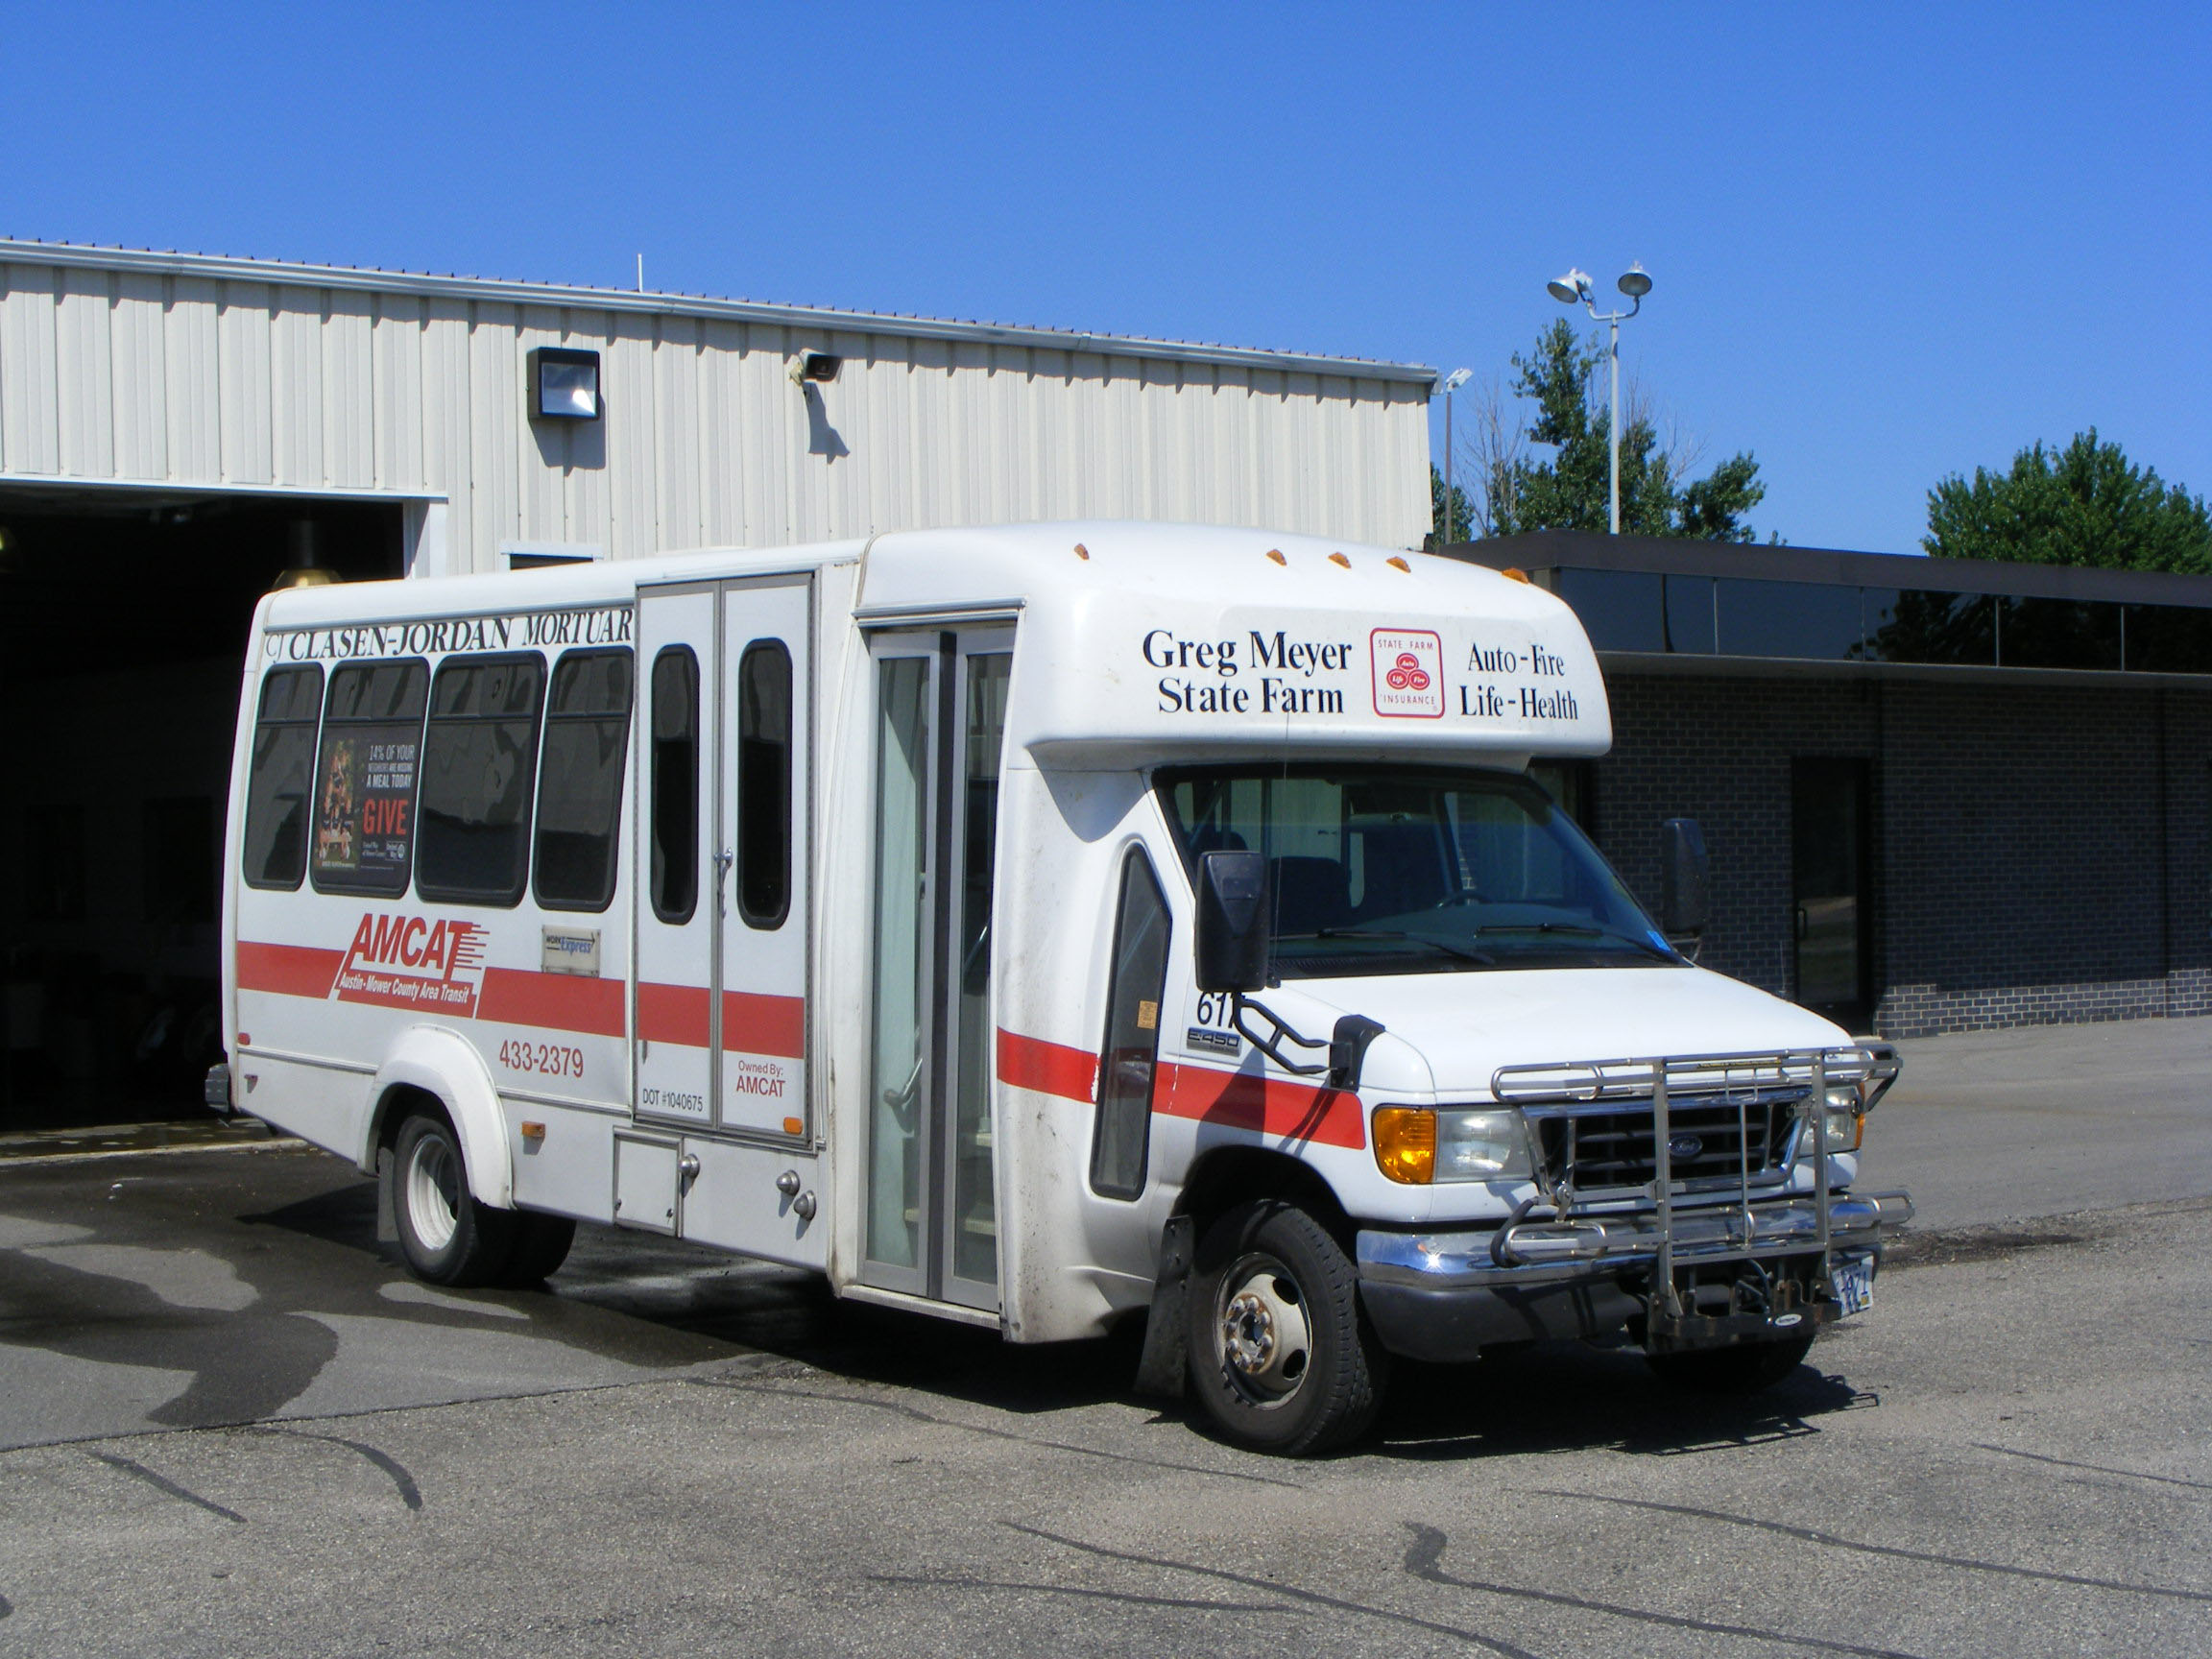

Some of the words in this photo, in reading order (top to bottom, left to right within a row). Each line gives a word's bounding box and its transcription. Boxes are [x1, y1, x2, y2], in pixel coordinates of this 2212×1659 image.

[288, 617, 515, 661] CLASEN-JORDAN
[521, 609, 634, 646] MORTUAR
[1378, 638, 1404, 649] STATE
[1409, 640, 1434, 651] FARM
[1142, 630, 1238, 678] Greg
[1248, 631, 1353, 678] Meyer
[1159, 677, 1249, 713] State
[1261, 677, 1344, 713] Farm
[1383, 694, 1435, 706] INSURANCE
[386, 744, 397, 760] OF
[397, 744, 416, 761] YOUR
[366, 774, 372, 788] A
[373, 774, 390, 788] MEAL
[391, 774, 413, 788] TODAY
[363, 798, 409, 835] GIVE
[338, 913, 474, 981] AMCAT
[392, 977, 421, 1002] County
[420, 981, 440, 1000] Area
[441, 983, 470, 1004] Transit
[499, 1040, 584, 1078] 433-2379
[737, 1060, 769, 1074] Owned
[769, 1063, 784, 1077] By:
[735, 1074, 786, 1098] AMCAT
[642, 1088, 661, 1106] DOT
[661, 1091, 704, 1113] #1040675
